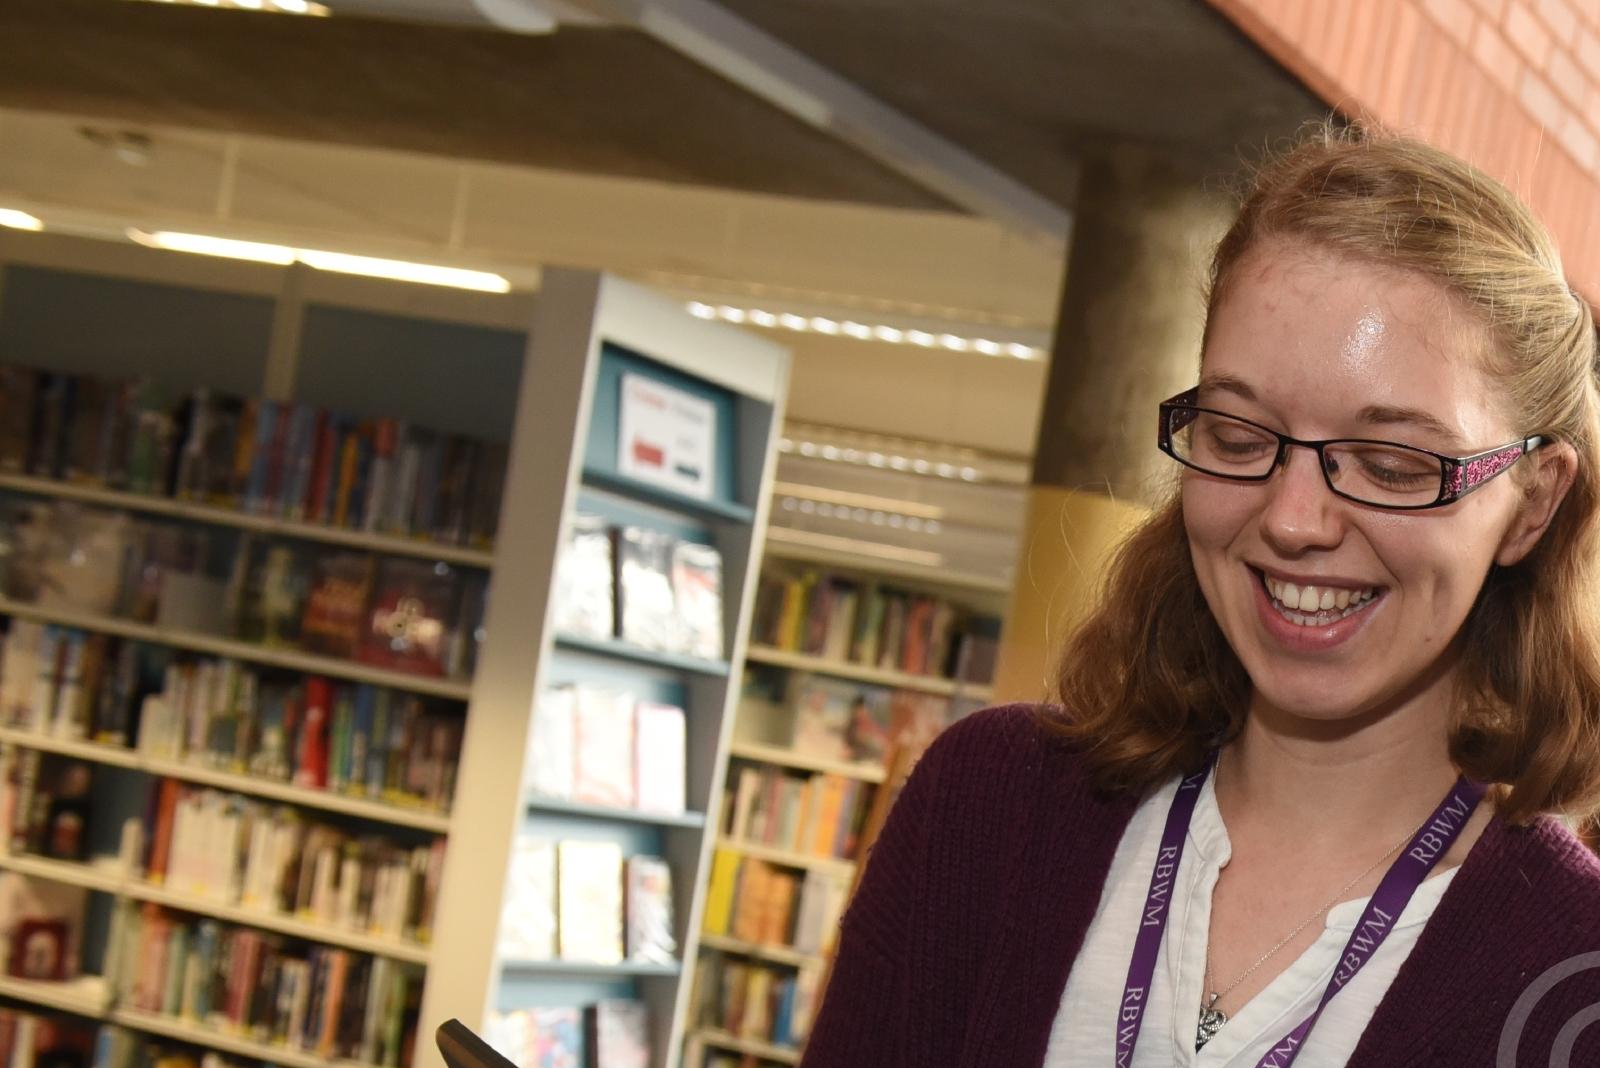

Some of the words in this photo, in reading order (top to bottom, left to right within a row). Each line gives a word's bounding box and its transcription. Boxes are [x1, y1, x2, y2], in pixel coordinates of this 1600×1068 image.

[1408, 793, 1470, 866] RBWM
[1142, 845, 1178, 927] RBWM
[1334, 905, 1393, 988] RBWM
